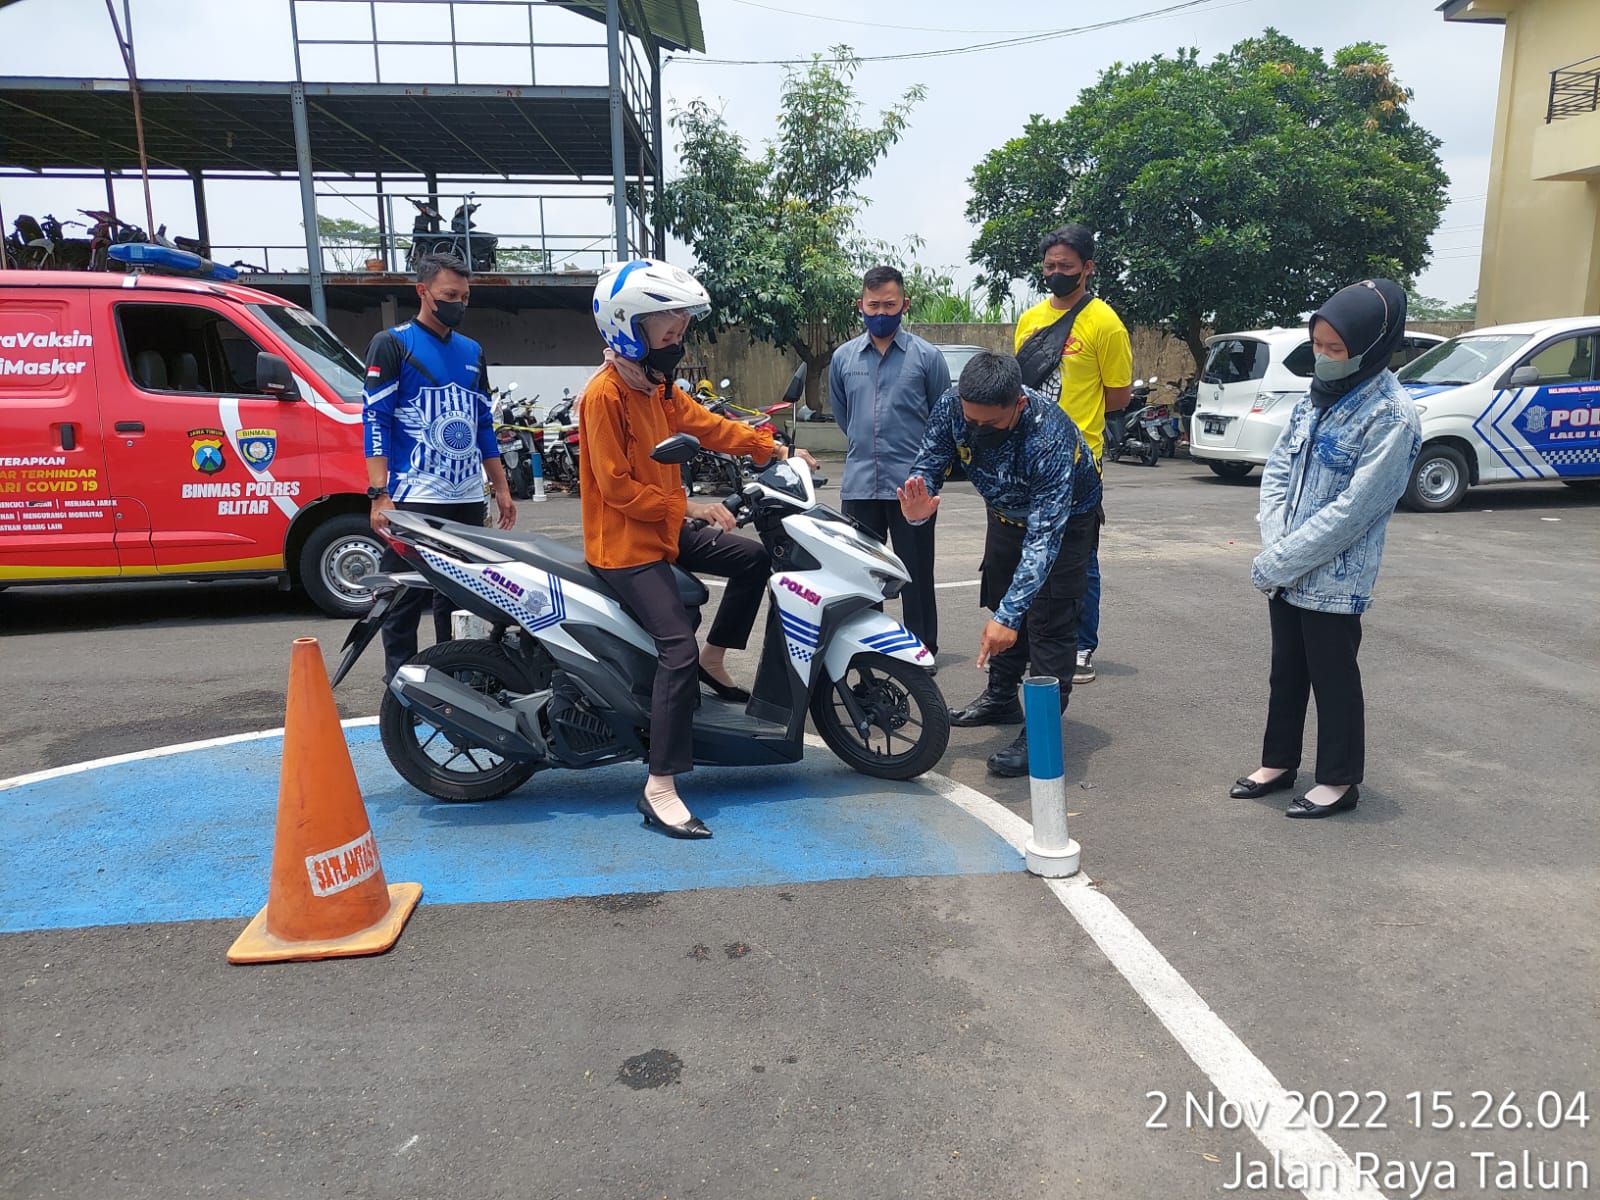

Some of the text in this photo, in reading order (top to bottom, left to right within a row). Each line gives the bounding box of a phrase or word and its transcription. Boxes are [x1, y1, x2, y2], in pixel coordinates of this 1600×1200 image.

[371, 422, 383, 456] LITAR
[1549, 431, 1586, 440] LALU
[21, 468, 97, 479] TERHINDAR
[26, 481, 78, 492] COVID
[82, 480, 98, 491] 19
[182, 481, 300, 498] BINMAS POLRES
[218, 500, 269, 515] BLITAR
[482, 567, 525, 597] POLISI
[778, 575, 822, 606] POLISI
